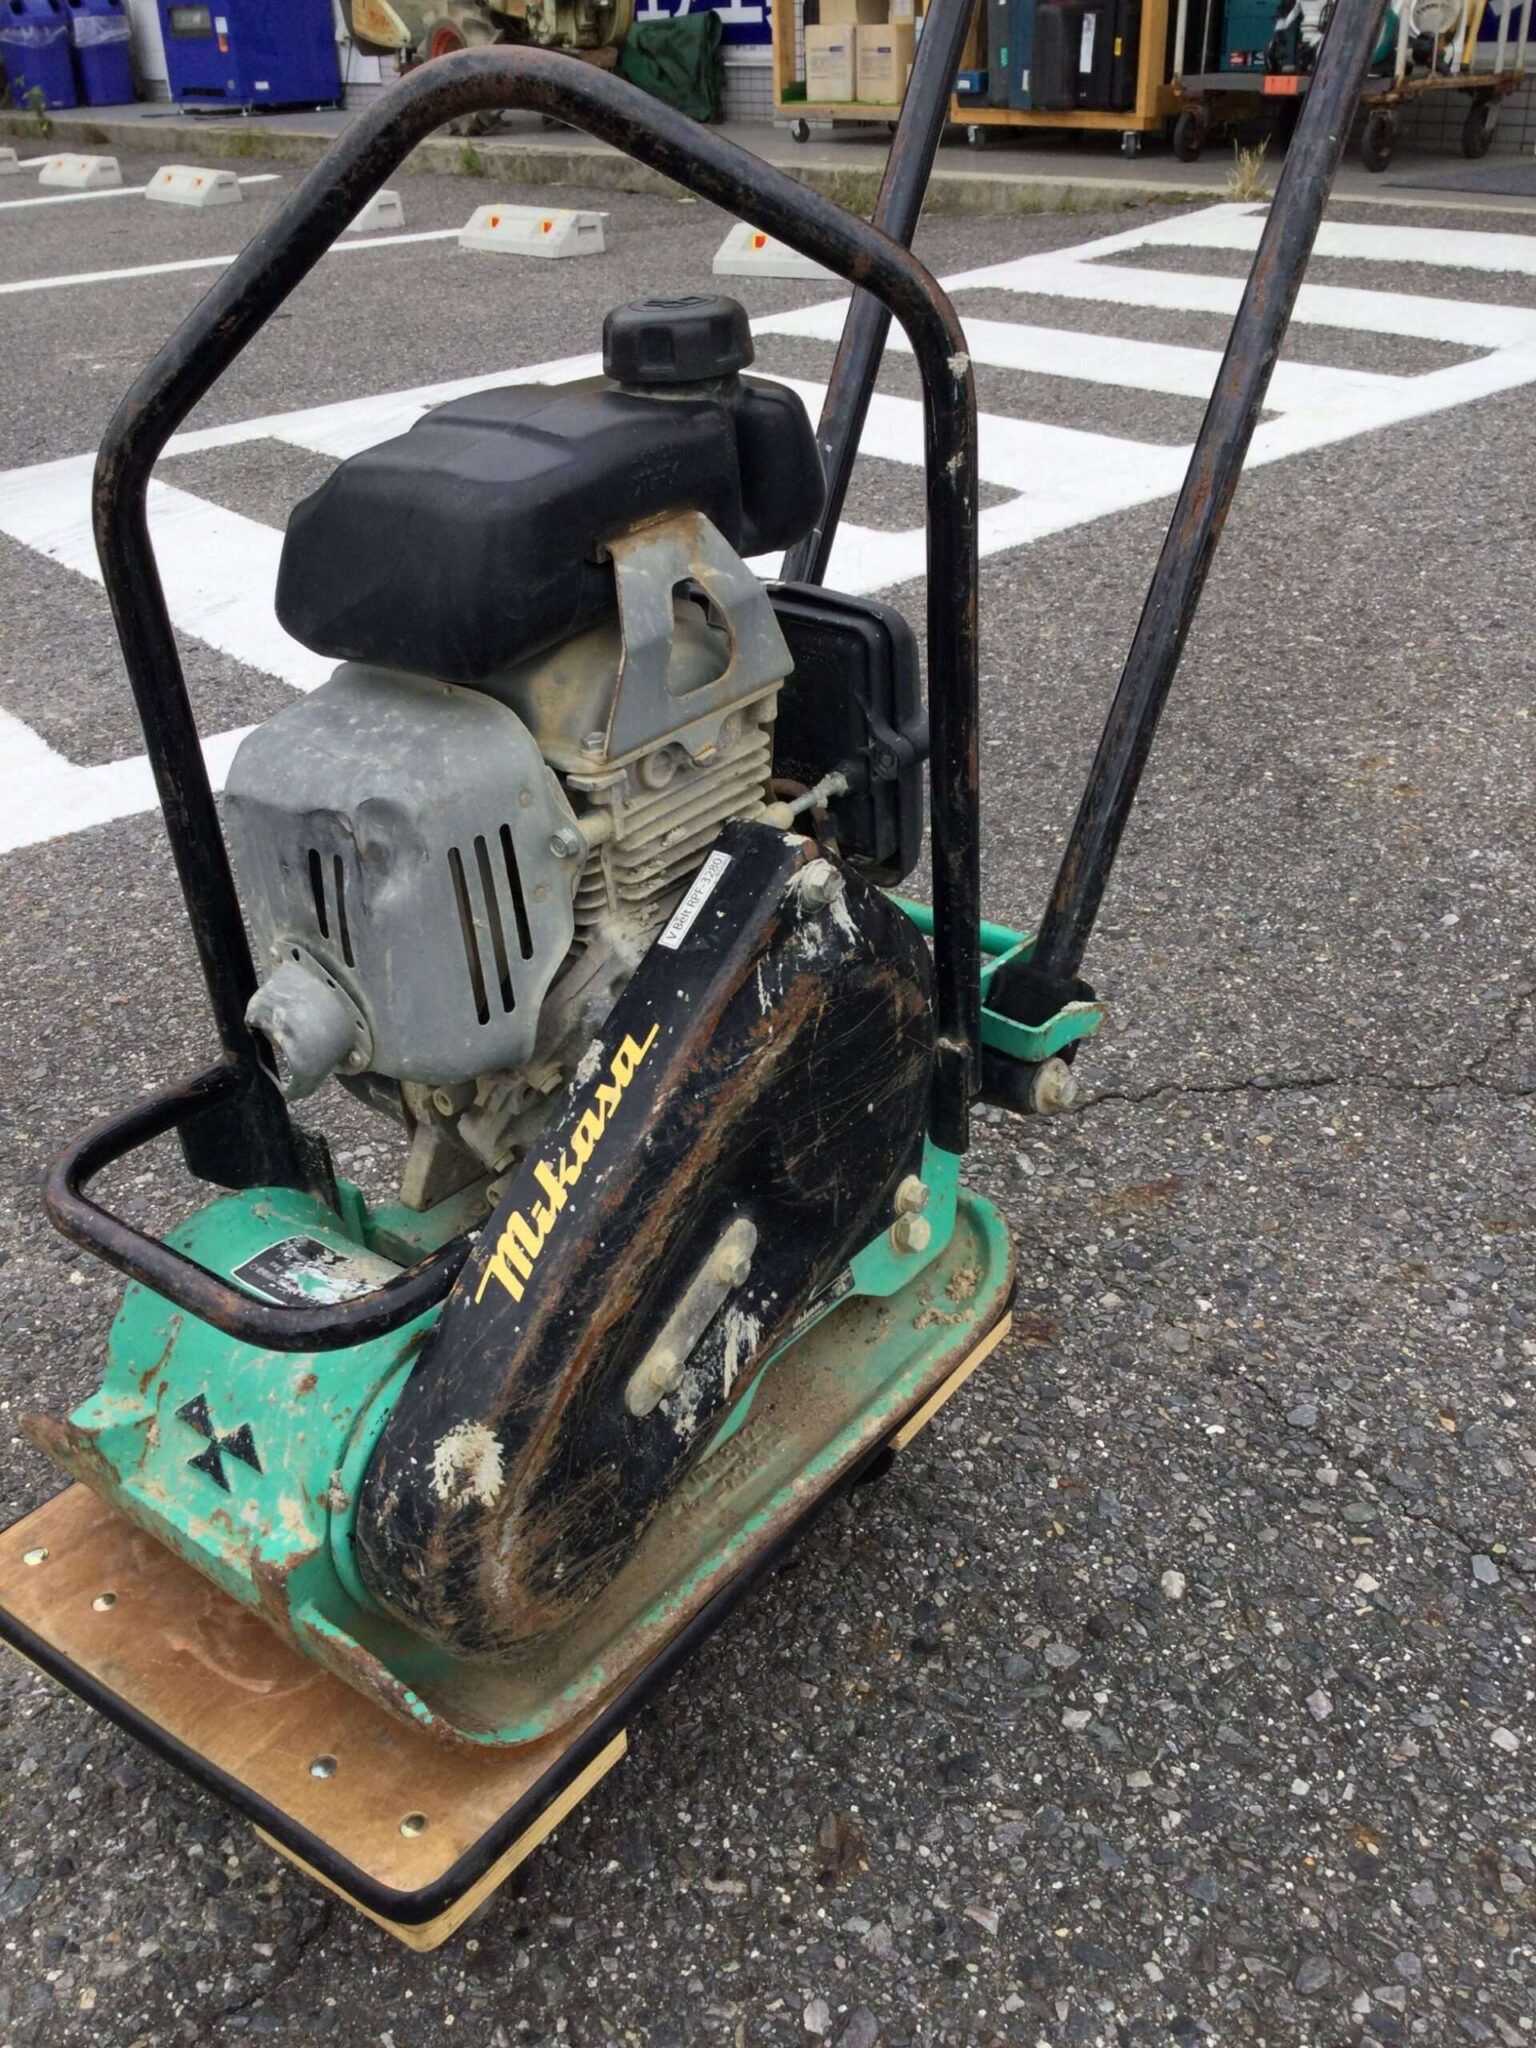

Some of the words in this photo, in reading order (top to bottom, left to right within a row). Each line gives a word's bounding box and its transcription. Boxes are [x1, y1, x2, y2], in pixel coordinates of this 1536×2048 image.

[666, 931, 677, 940] V
[673, 910, 692, 930] Belt
[687, 857, 723, 908] RPF-3280
[474, 1023, 660, 1304] Mikasa
